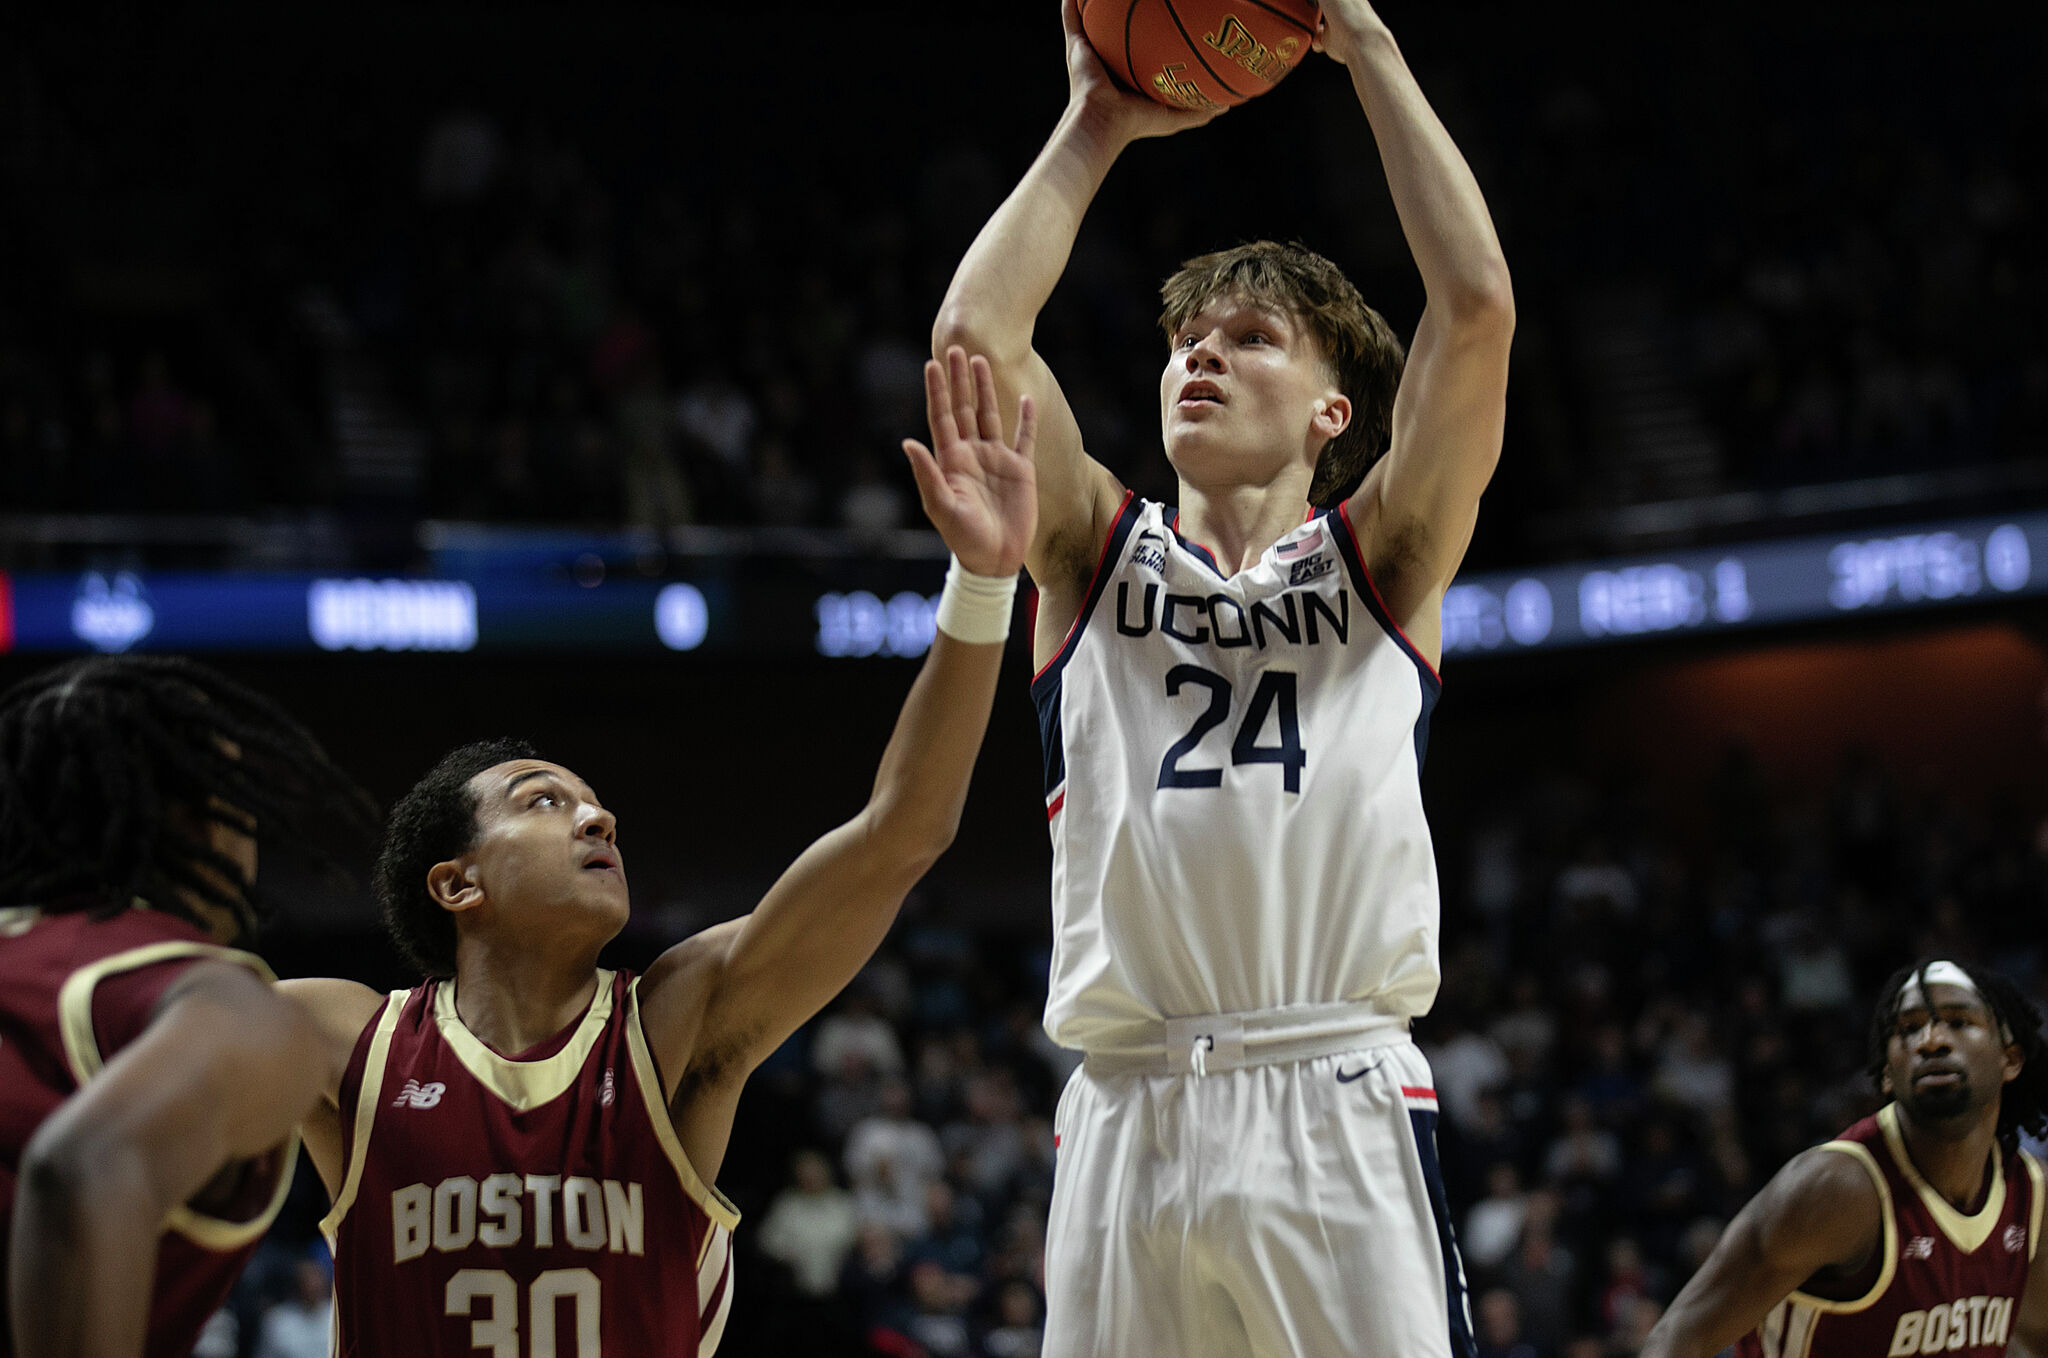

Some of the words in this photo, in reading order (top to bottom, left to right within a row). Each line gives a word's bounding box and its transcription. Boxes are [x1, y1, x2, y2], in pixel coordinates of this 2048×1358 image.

[1289, 559, 1335, 586] EAST
[1291, 552, 1323, 575] BIG
[1116, 582, 1348, 649] UCONN
[1156, 664, 1306, 794] 24
[391, 1172, 645, 1266] BOSTON
[444, 1267, 602, 1358] 30
